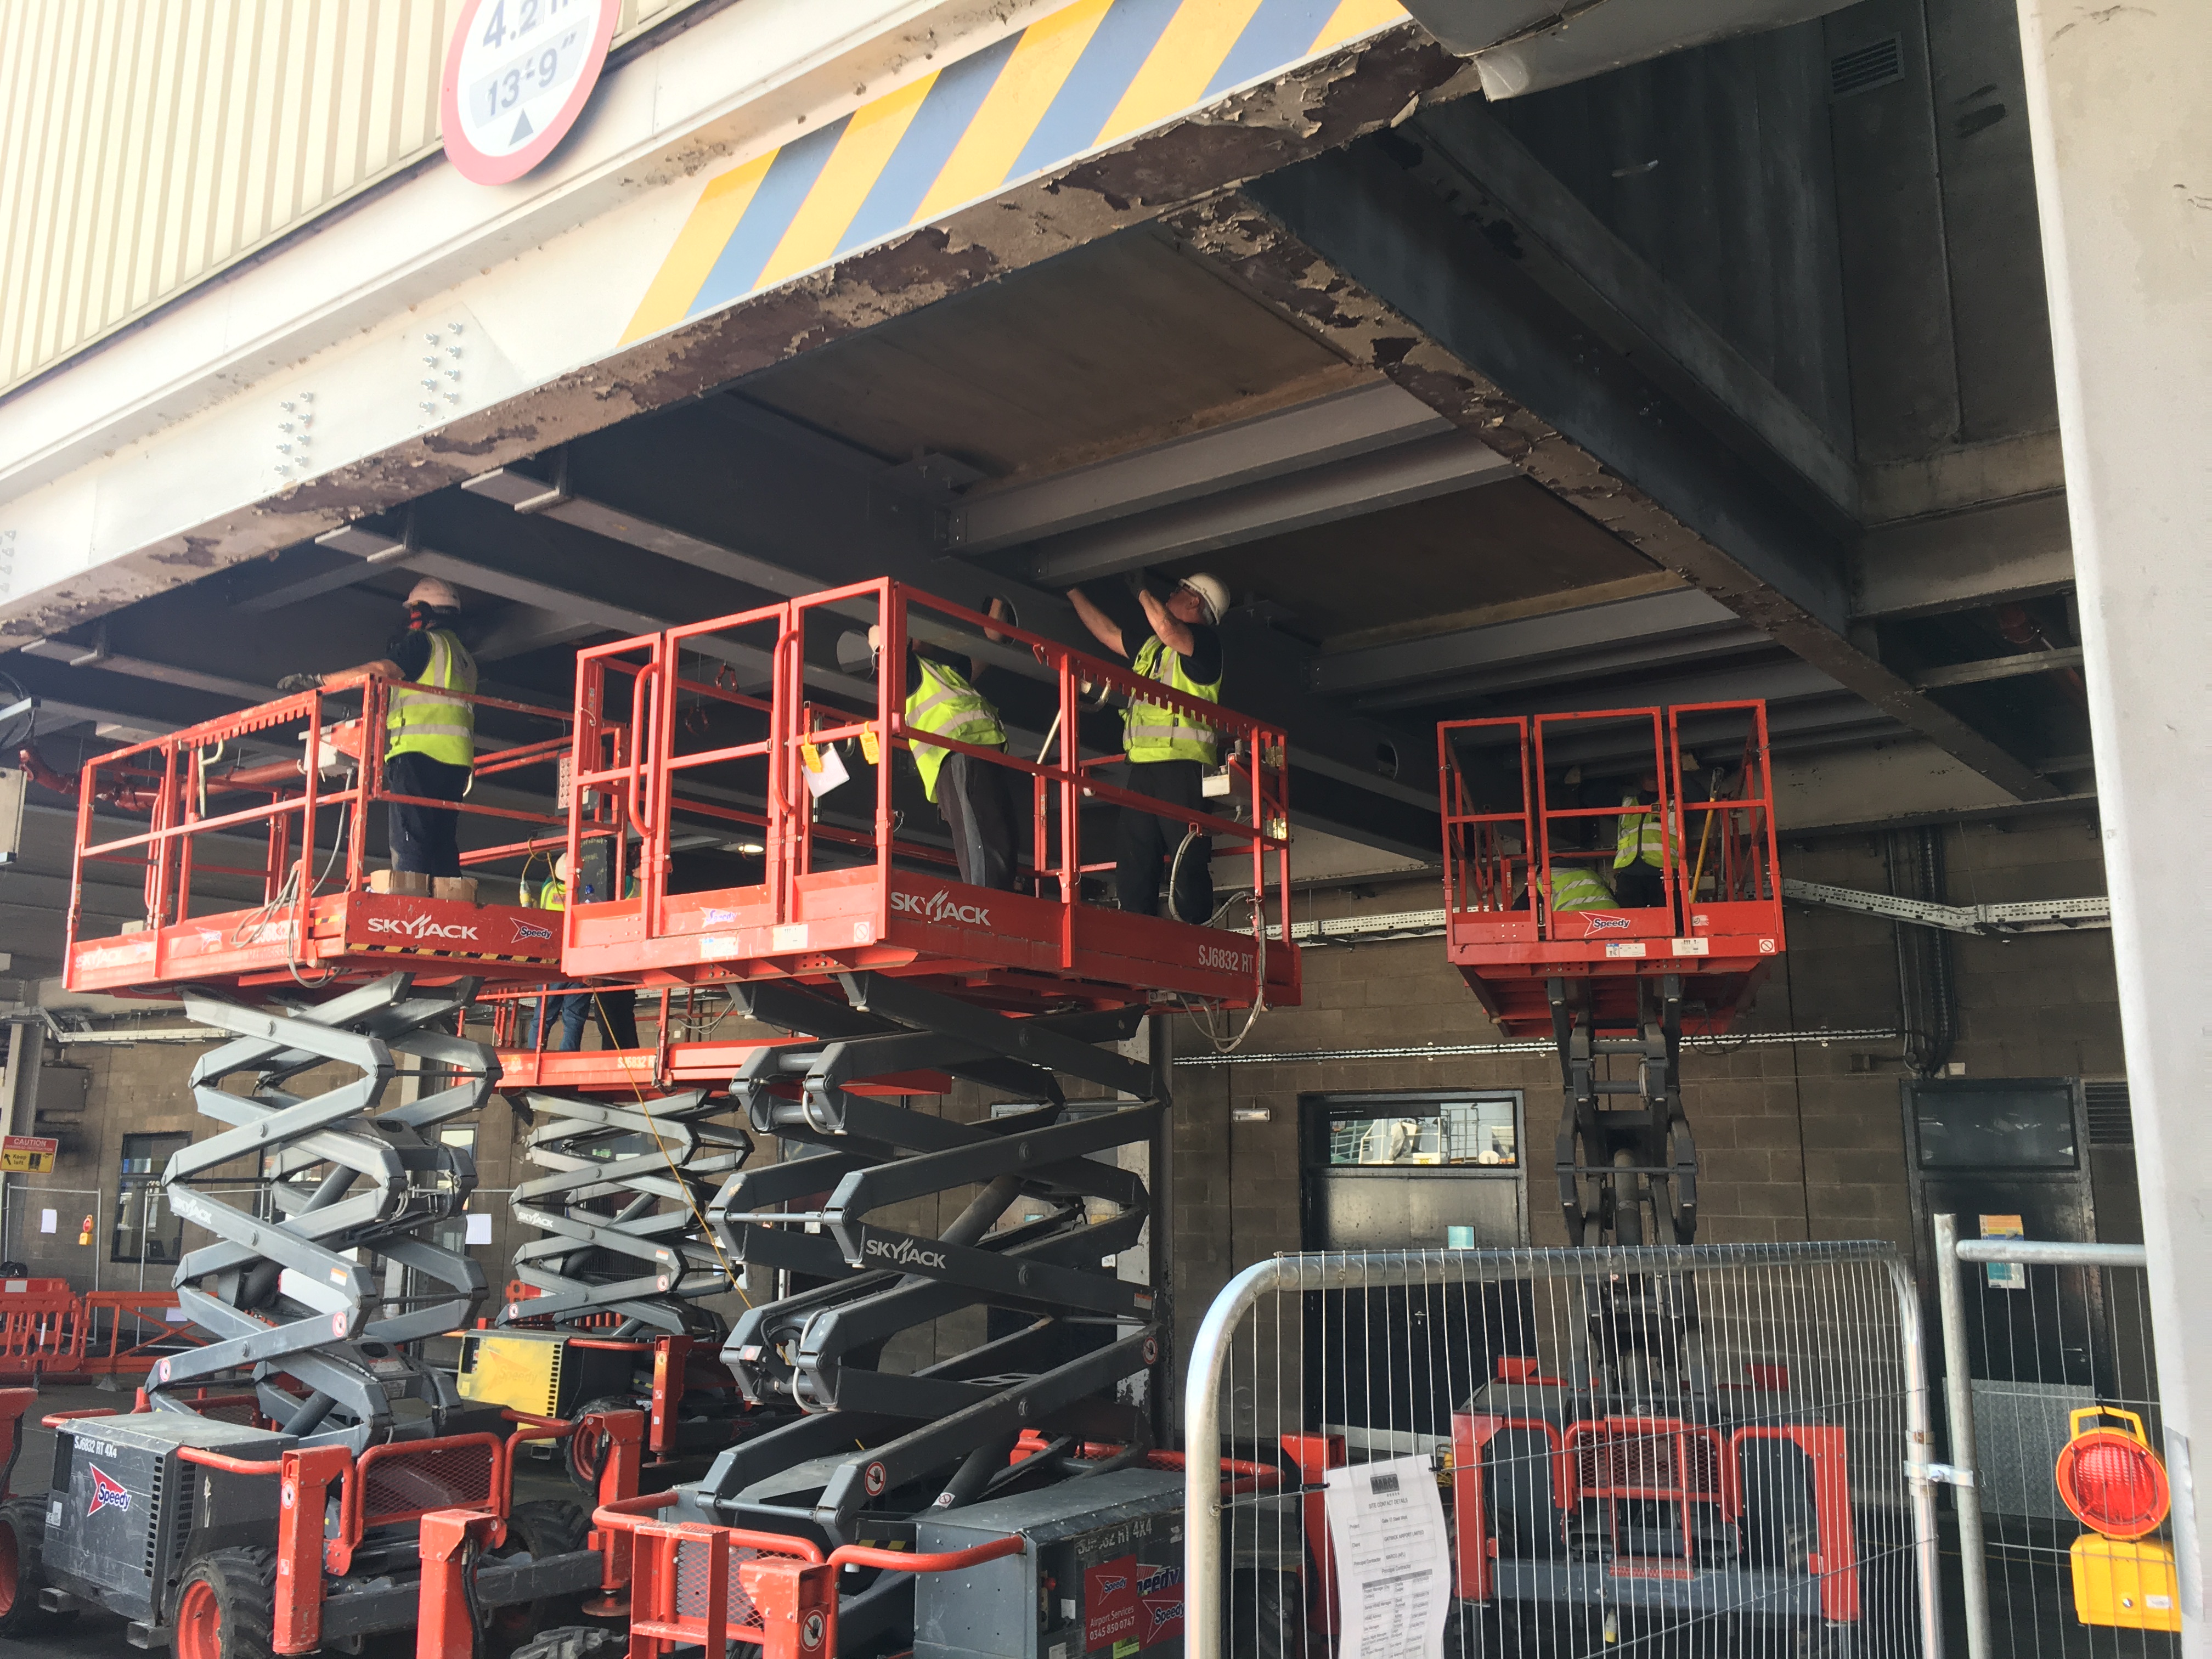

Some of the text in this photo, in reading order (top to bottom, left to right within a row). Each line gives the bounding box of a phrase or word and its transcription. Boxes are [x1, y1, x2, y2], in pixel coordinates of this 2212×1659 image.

[482, 0, 539, 49] 4.2
[890, 889, 991, 926] SKYJACK
[368, 913, 479, 940] SKYJACK
[520, 926, 552, 939] Speedy
[1593, 917, 1630, 929] Speedy
[76, 944, 122, 968] SKYJACK
[1198, 944, 1254, 974] SJ6832 RT
[14, 1138, 47, 1147] CAUTION
[172, 1197, 212, 1224] SKYJACK
[517, 1212, 554, 1228] SKYJACK
[866, 1238, 946, 1269] SKYJACK
[74, 1435, 95, 1453] SJ6832
[95, 1441, 105, 1455] RT
[1372, 1476, 1398, 1491] MARCO
[98, 1481, 132, 1512] Speedy
[1132, 1518, 1153, 1538] 4X4
[1104, 1577, 1127, 1594] Speedy
[1090, 1605, 1134, 1628] Airport Services
[1154, 1603, 1184, 1626] Speedy
[1090, 1616, 1135, 1641] 0345 850 0747
